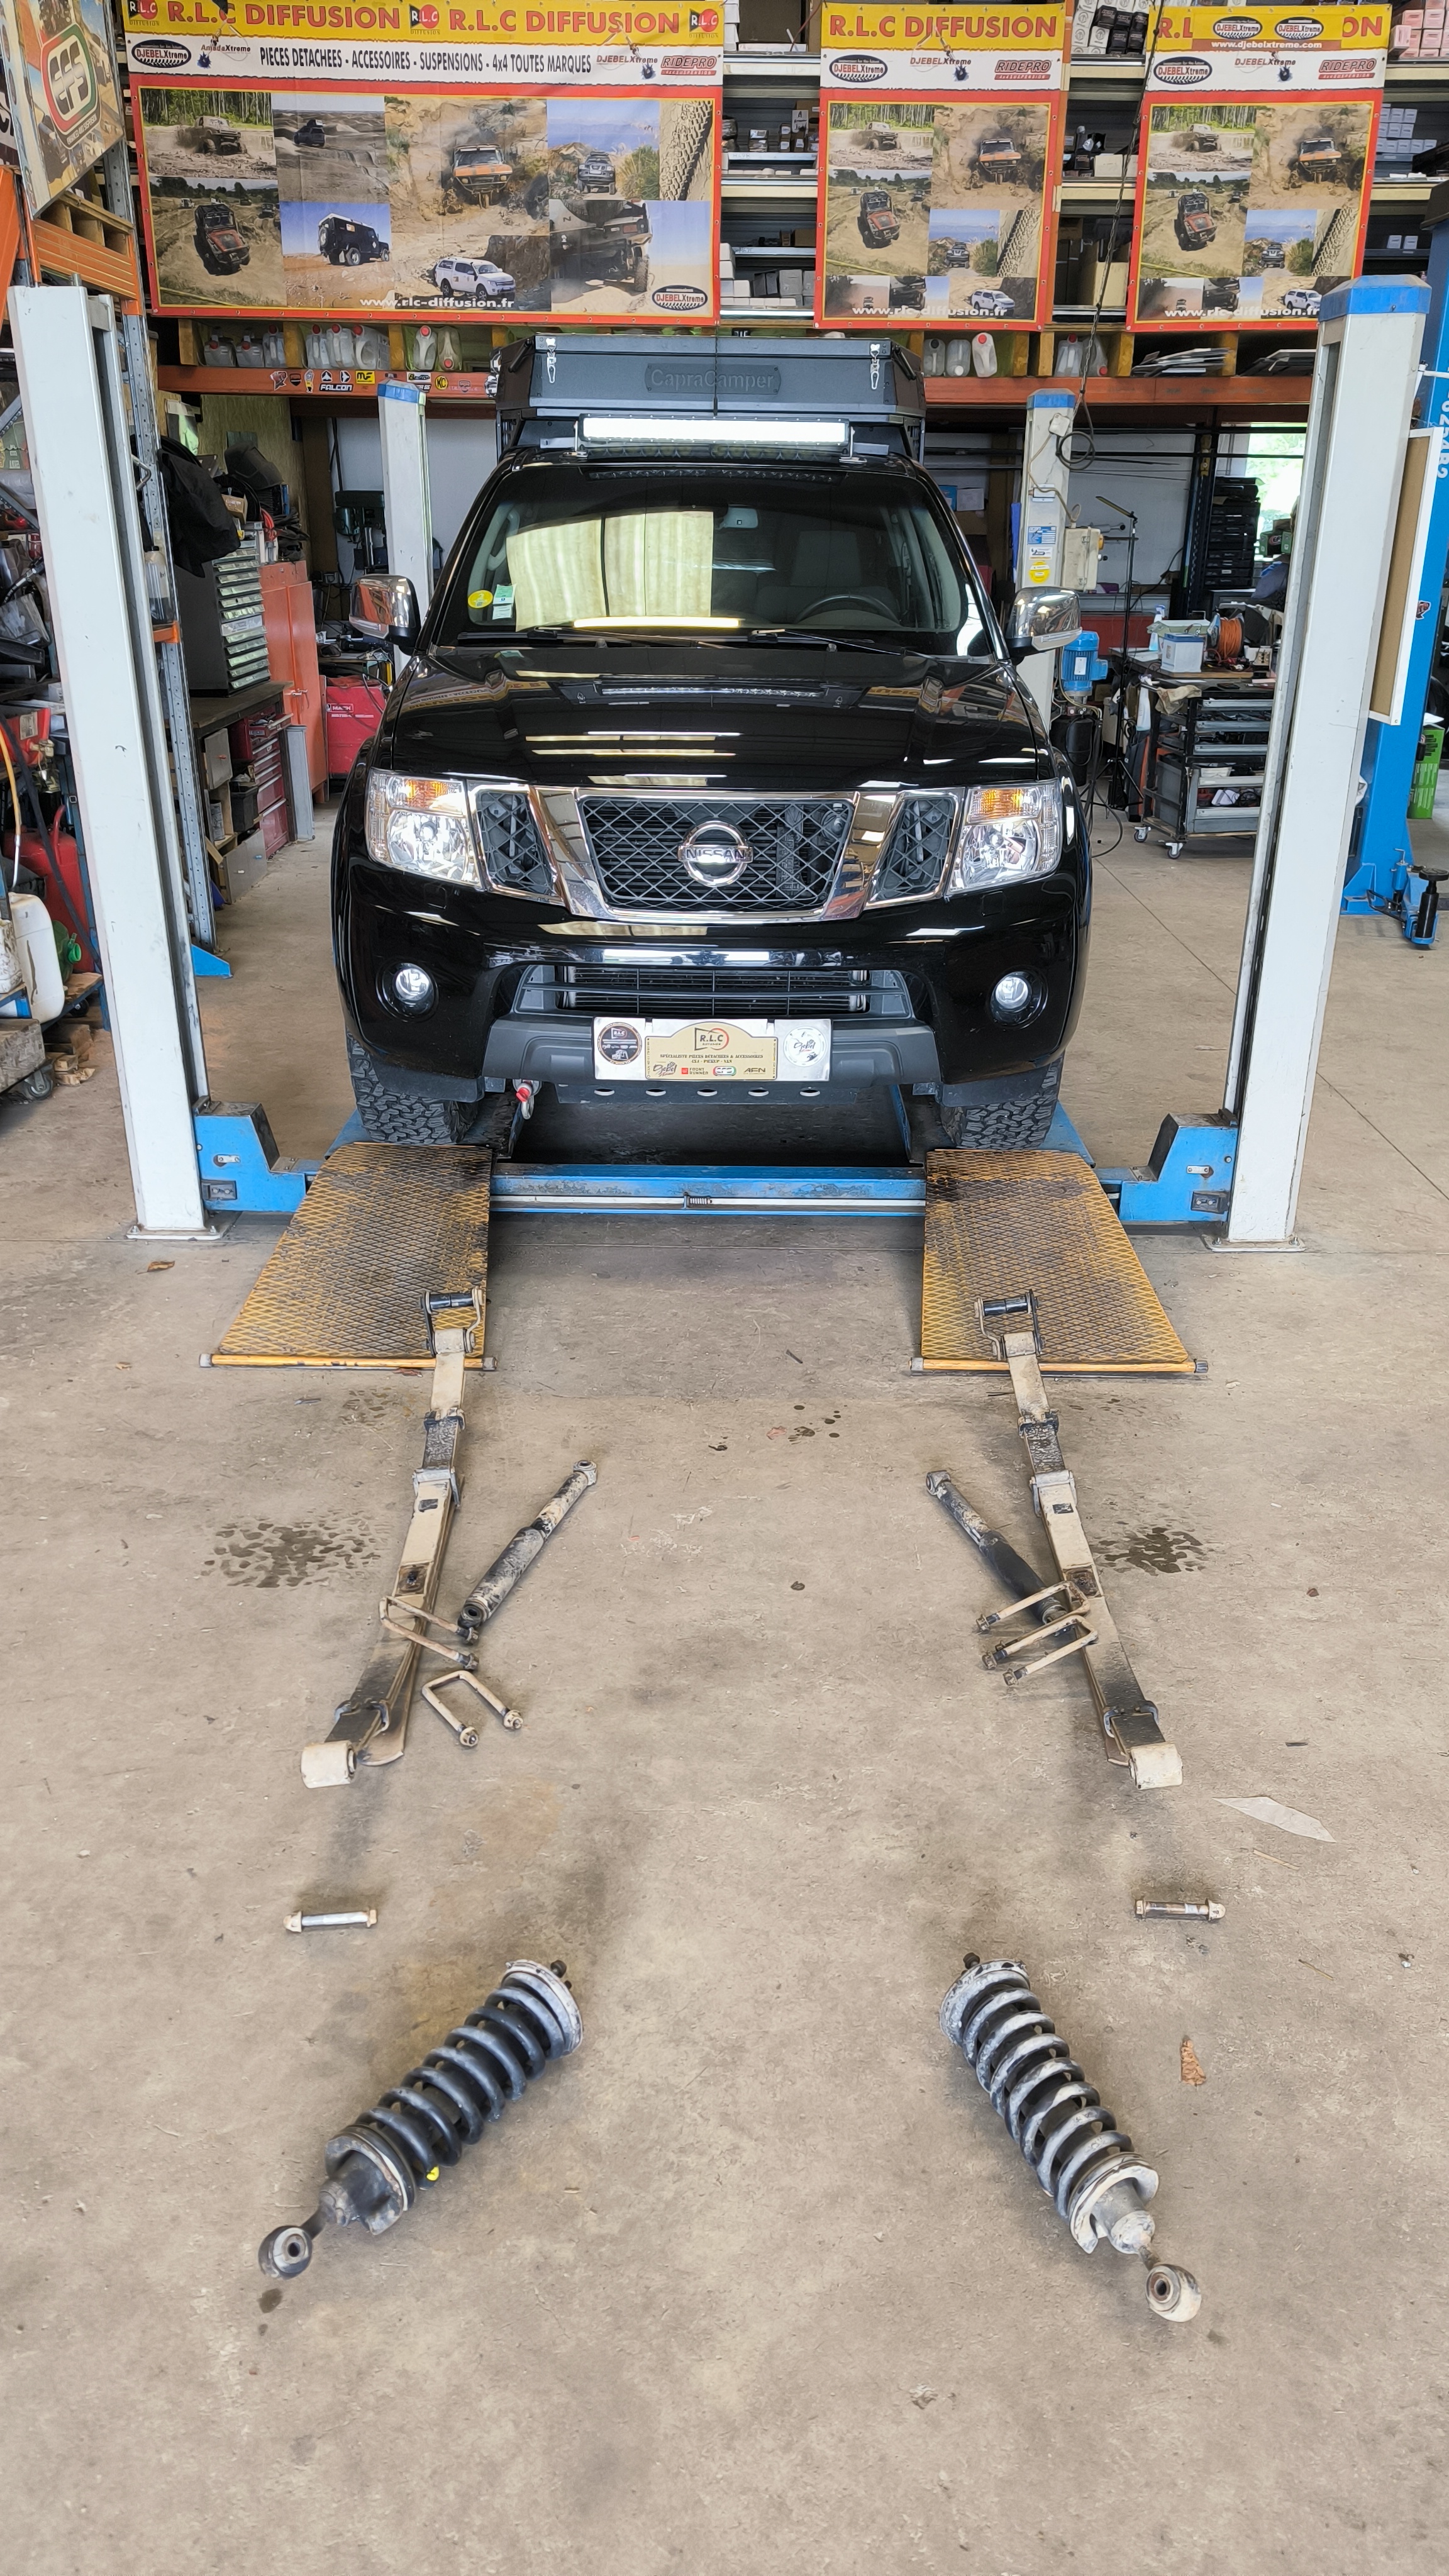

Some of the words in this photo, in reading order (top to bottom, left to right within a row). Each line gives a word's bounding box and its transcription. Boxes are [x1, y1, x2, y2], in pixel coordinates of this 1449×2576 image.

[130, 1, 157, 13] R.L.C
[167, 1, 236, 24] R.L.C
[245, 3, 400, 29] DIFFUSION
[411, 11, 438, 22] R.L.C
[449, 9, 516, 31] R.L.C
[526, 11, 679, 33] DIFFUSION
[691, 14, 718, 26] R.L.C
[830, 15, 896, 37] R.L.C
[905, 16, 1057, 38] DIFFUSION
[1211, 41, 1323, 50] www.djebelxtreme.com
[260, 47, 289, 66] PIECES
[292, 48, 342, 68] DETACHEES
[352, 50, 410, 69] ACCESSOIRES
[419, 52, 483, 72] SUSPENSIONS
[492, 54, 508, 72] 4x4
[510, 54, 545, 72] TOUTES
[547, 55, 591, 74] MARQUES
[661, 55, 717, 69] RIDEPRO
[995, 60, 1052, 72] RIDEPRO
[1319, 58, 1377, 72] RIDEPRO
[359, 297, 515, 308] www.rlc-diffusion.fr
[852, 305, 1008, 316] www.rlc-diffusion.fr
[1165, 306, 1320, 317] www.rlc-diffusion.fr
[436, 378, 447, 387] KC
[651, 369, 775, 391] CapraCamper
[686, 849, 747, 860] NISSAN
[700, 1034, 724, 1042] R.L.C
